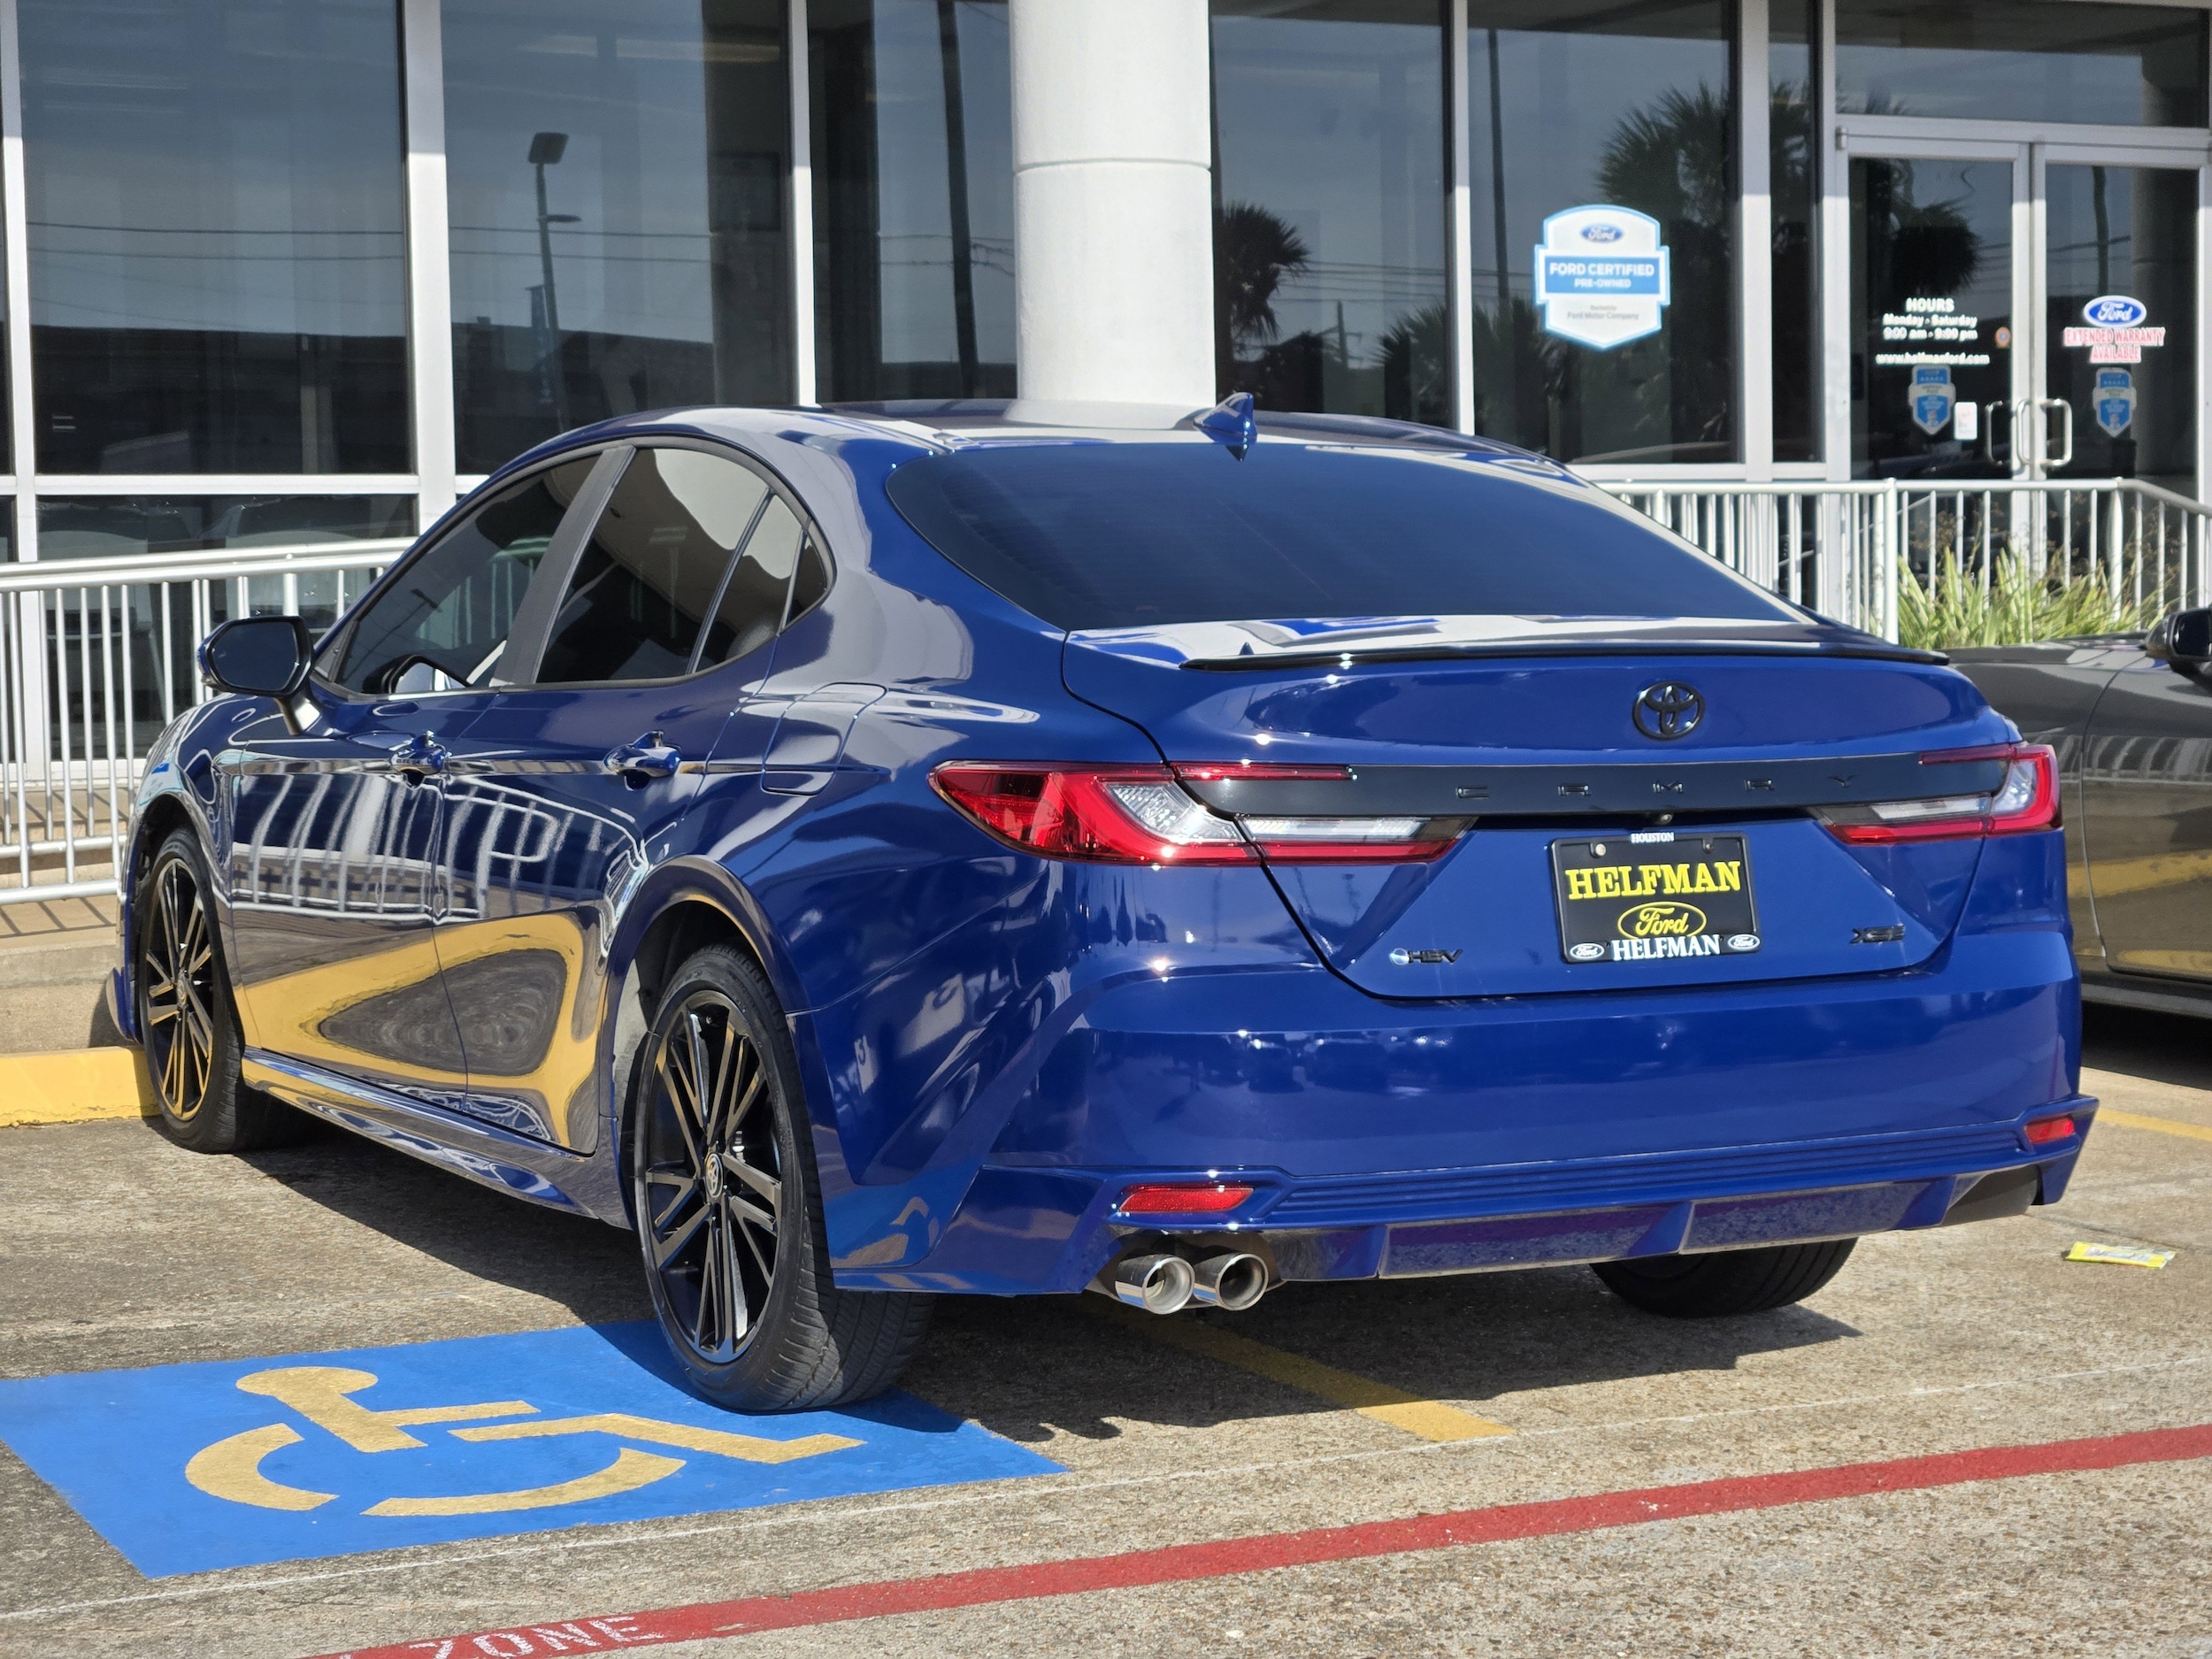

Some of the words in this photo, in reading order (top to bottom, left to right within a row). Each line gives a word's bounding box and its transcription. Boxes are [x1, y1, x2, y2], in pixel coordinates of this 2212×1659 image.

[1549, 262, 1586, 276] FORD
[1587, 263, 1655, 277] CERTIFIED
[1574, 278, 1632, 288] PRE-OWNED
[1905, 297, 1955, 312] HOURS
[2097, 301, 2133, 321] Ford
[1883, 312, 1924, 327] Monday
[1931, 313, 1978, 328] Saturday
[1909, 329, 1927, 340] am
[1959, 329, 1978, 342] pm
[2064, 327, 2114, 346] EXTENDED
[2114, 327, 2166, 346] WARRANTY
[2090, 345, 2141, 363] AVAILABLE
[1455, 774, 1856, 799] CAMRY
[1630, 832, 1675, 844] HOUSTON
[1564, 860, 1741, 901] HELFMAN
[1634, 907, 1690, 936] Ford
[1611, 933, 1722, 962] HELFMAN
[1407, 949, 1463, 964] HEV
